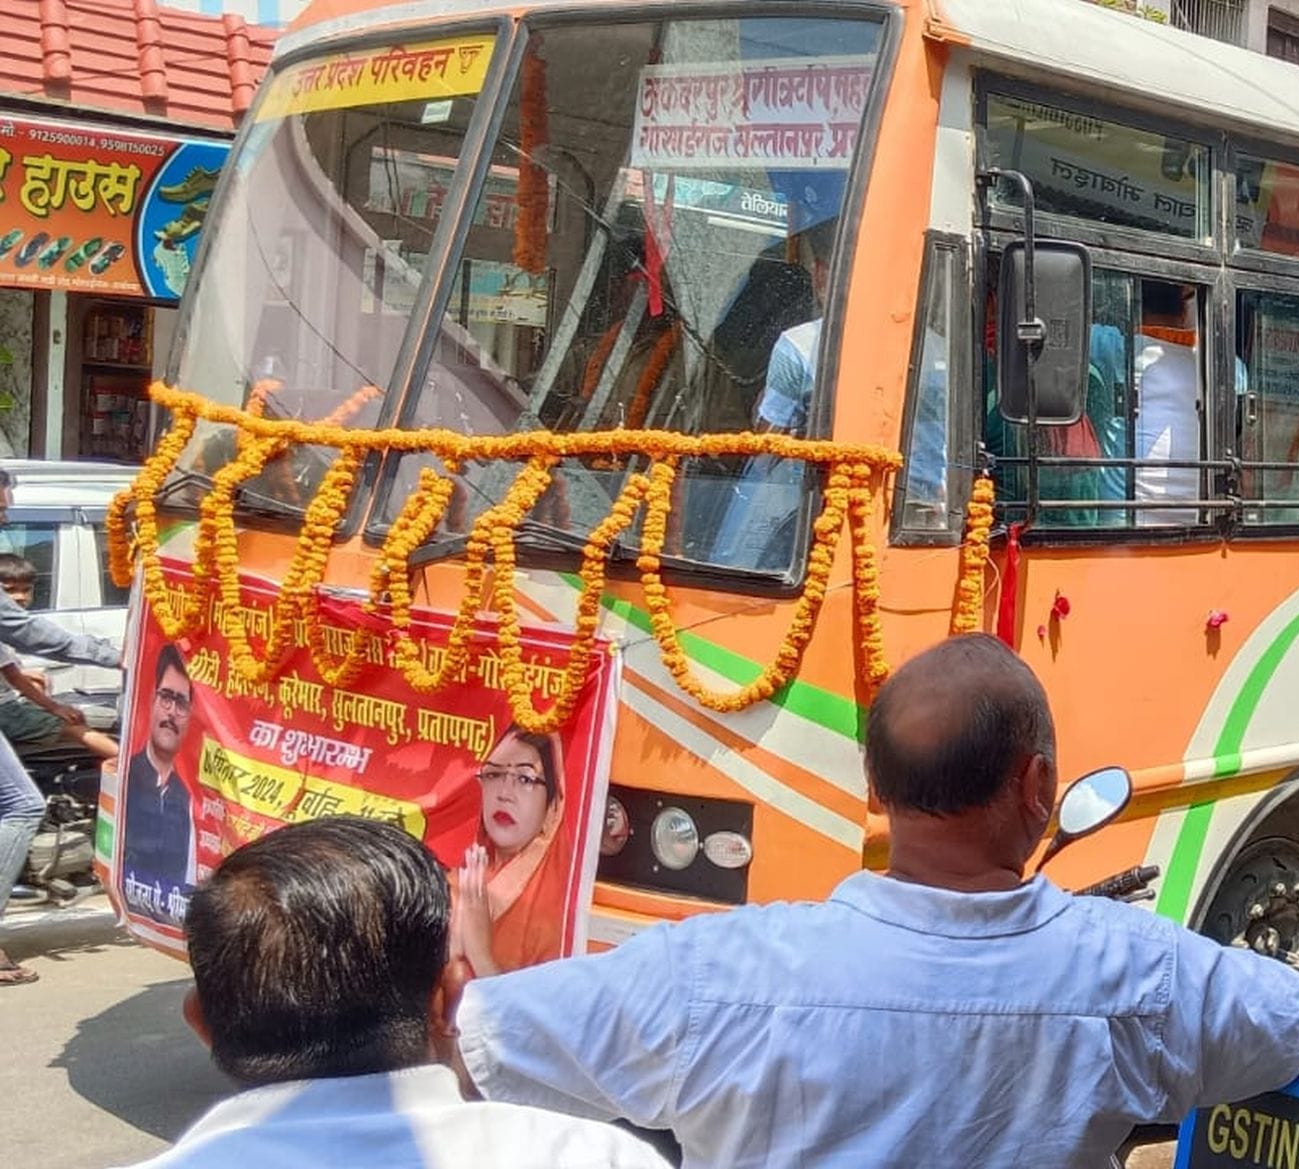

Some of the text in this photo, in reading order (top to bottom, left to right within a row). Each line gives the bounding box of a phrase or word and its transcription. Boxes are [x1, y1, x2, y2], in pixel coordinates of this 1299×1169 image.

[325, 53, 369, 90] प्रदेश
[371, 43, 455, 85] परिवहन
[21, 153, 141, 216] हाउस
[332, 688, 412, 746] सुलतानपुर,
[249, 718, 373, 774] का शुभारम्भ
